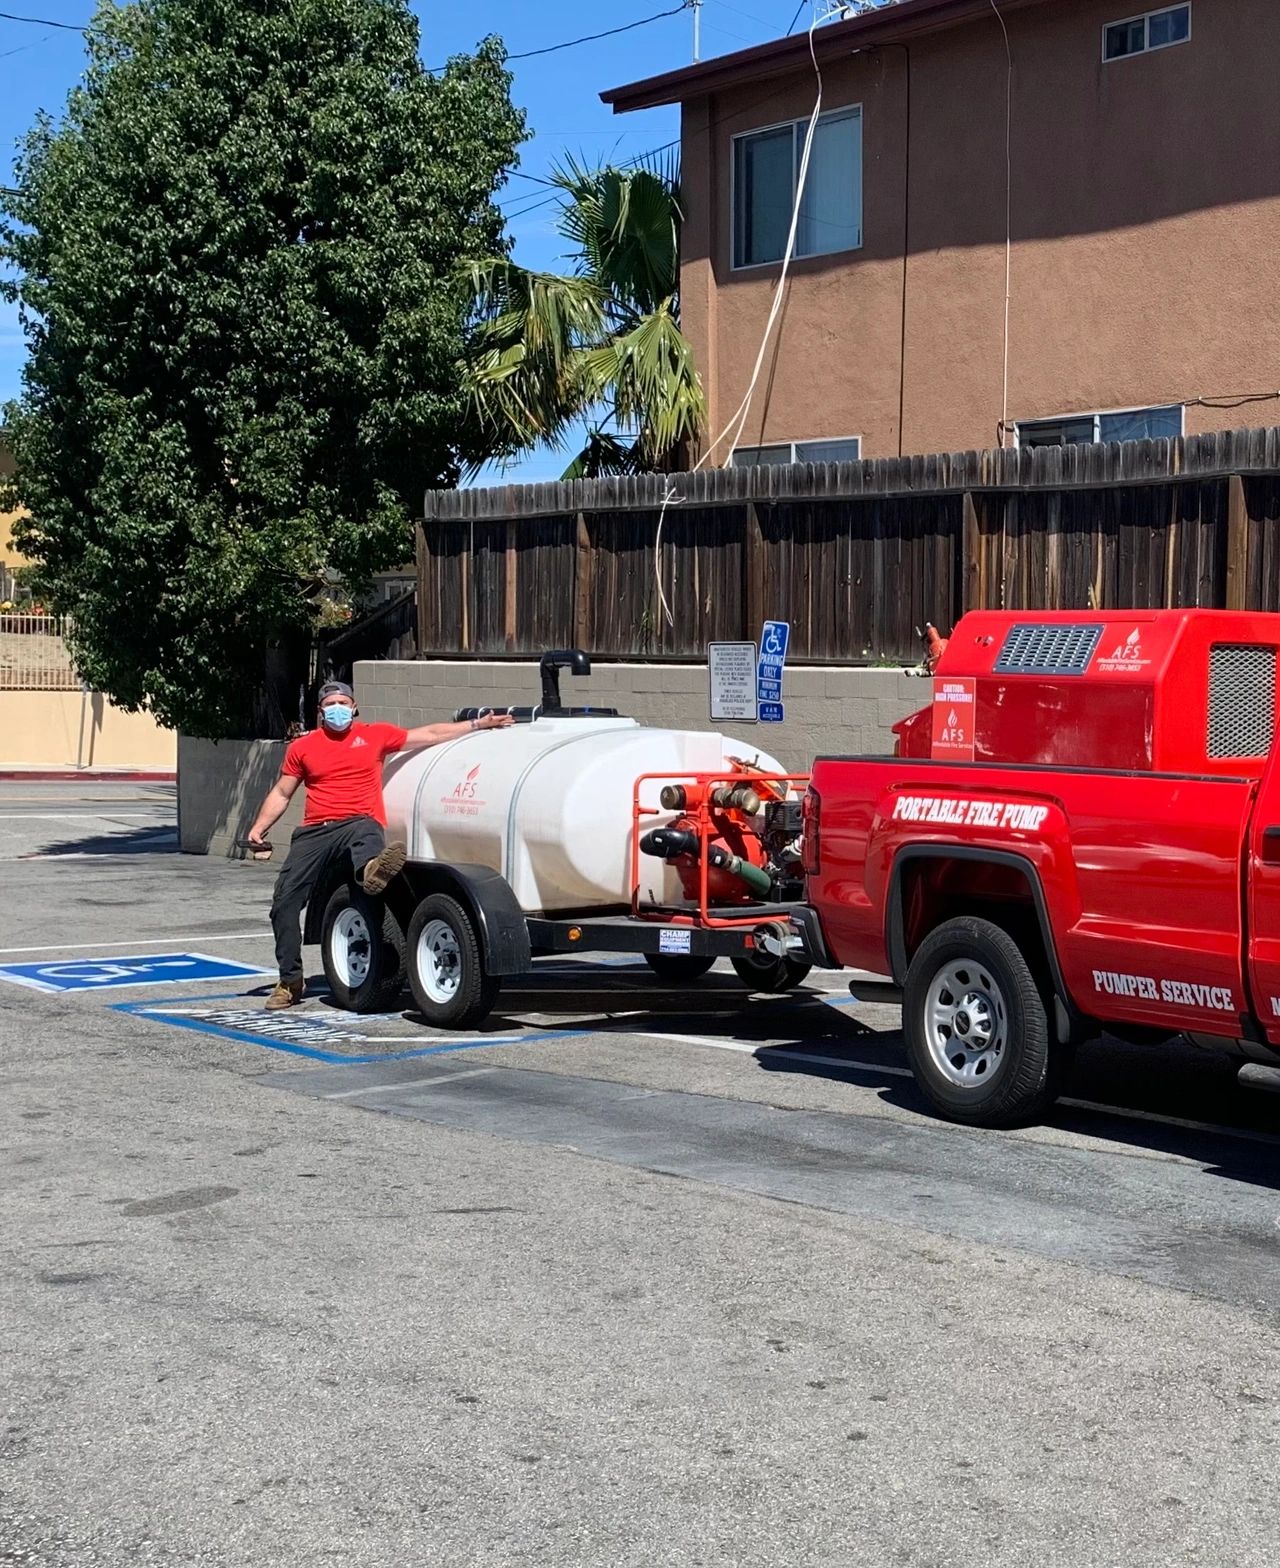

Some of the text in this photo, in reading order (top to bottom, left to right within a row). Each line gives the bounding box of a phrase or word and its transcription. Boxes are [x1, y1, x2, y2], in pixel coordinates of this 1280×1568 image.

[1111, 645, 1142, 659] AFS
[761, 653, 783, 667] PARKING
[763, 666, 777, 678] ONLY
[760, 689, 769, 698] FINE
[769, 690, 780, 700] $250
[942, 728, 964, 742] AFS
[453, 782, 477, 798] AFS
[892, 796, 1048, 831] PORTABLE FIRE PUMP
[1092, 970, 1235, 1011] PUMPER SERVICE
[190, 1009, 368, 1044] PARKING
